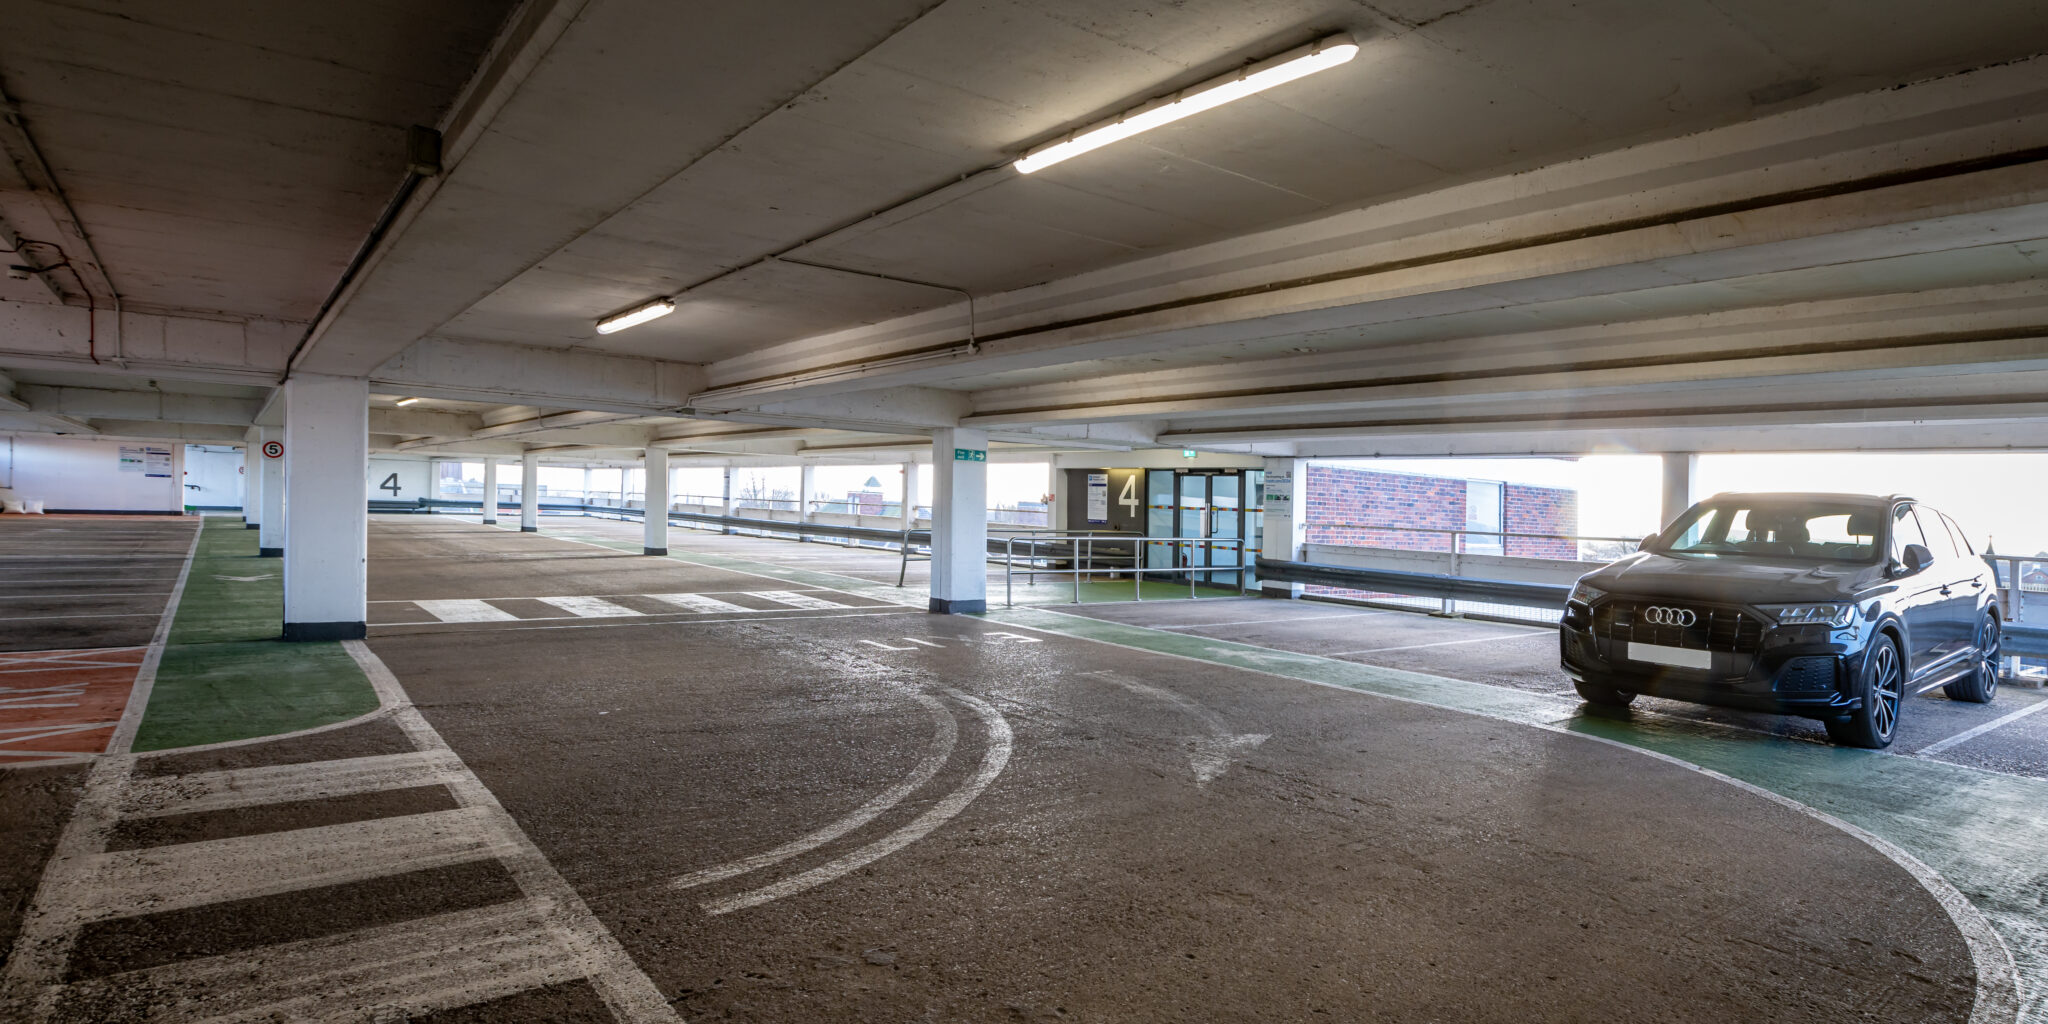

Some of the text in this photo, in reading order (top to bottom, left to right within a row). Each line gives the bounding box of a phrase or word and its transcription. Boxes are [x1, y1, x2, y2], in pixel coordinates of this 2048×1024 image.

[268, 444, 279, 455] 5
[379, 472, 402, 497] 4
[1118, 474, 1140, 518] 4
